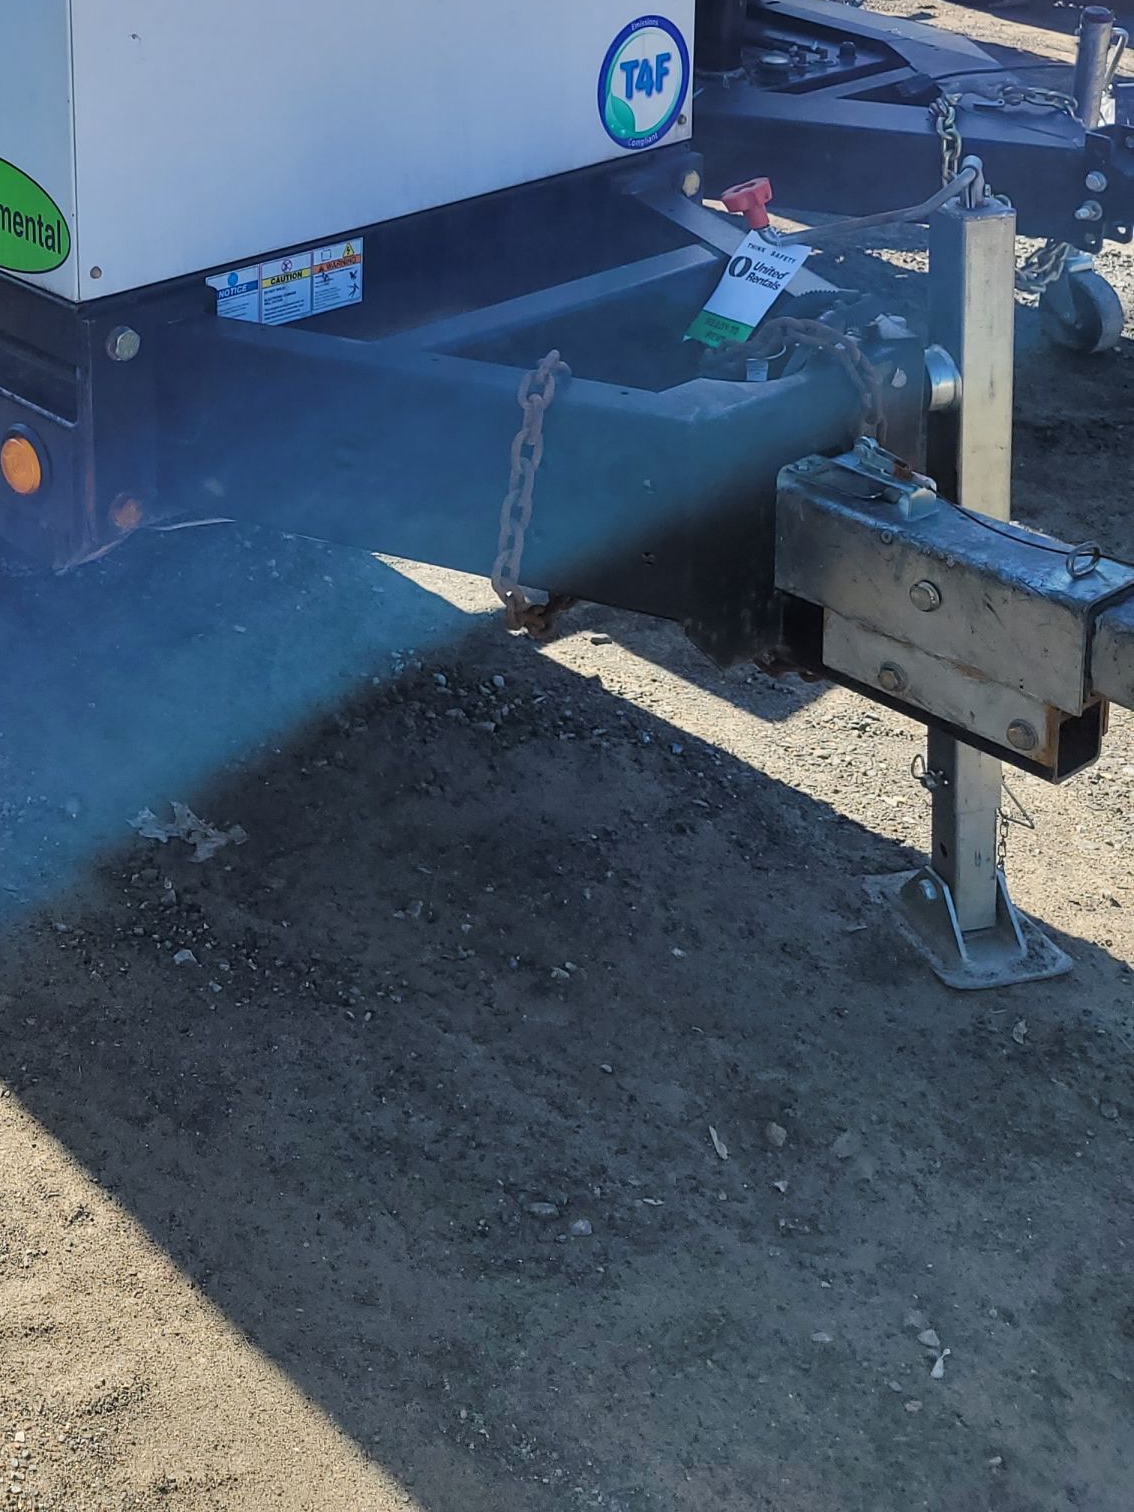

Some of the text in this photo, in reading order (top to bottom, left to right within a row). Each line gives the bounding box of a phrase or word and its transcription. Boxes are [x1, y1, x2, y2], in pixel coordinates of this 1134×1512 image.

[631, 19, 659, 30] Emissions
[619, 52, 672, 100] T4F
[627, 132, 658, 147] Compliant
[747, 242, 797, 264] THINK SAFETY
[326, 255, 358, 271] WARNING
[753, 261, 787, 280] United
[270, 271, 303, 285] CAUTION
[746, 272, 781, 291] Rentals
[218, 284, 248, 298] NOTICE
